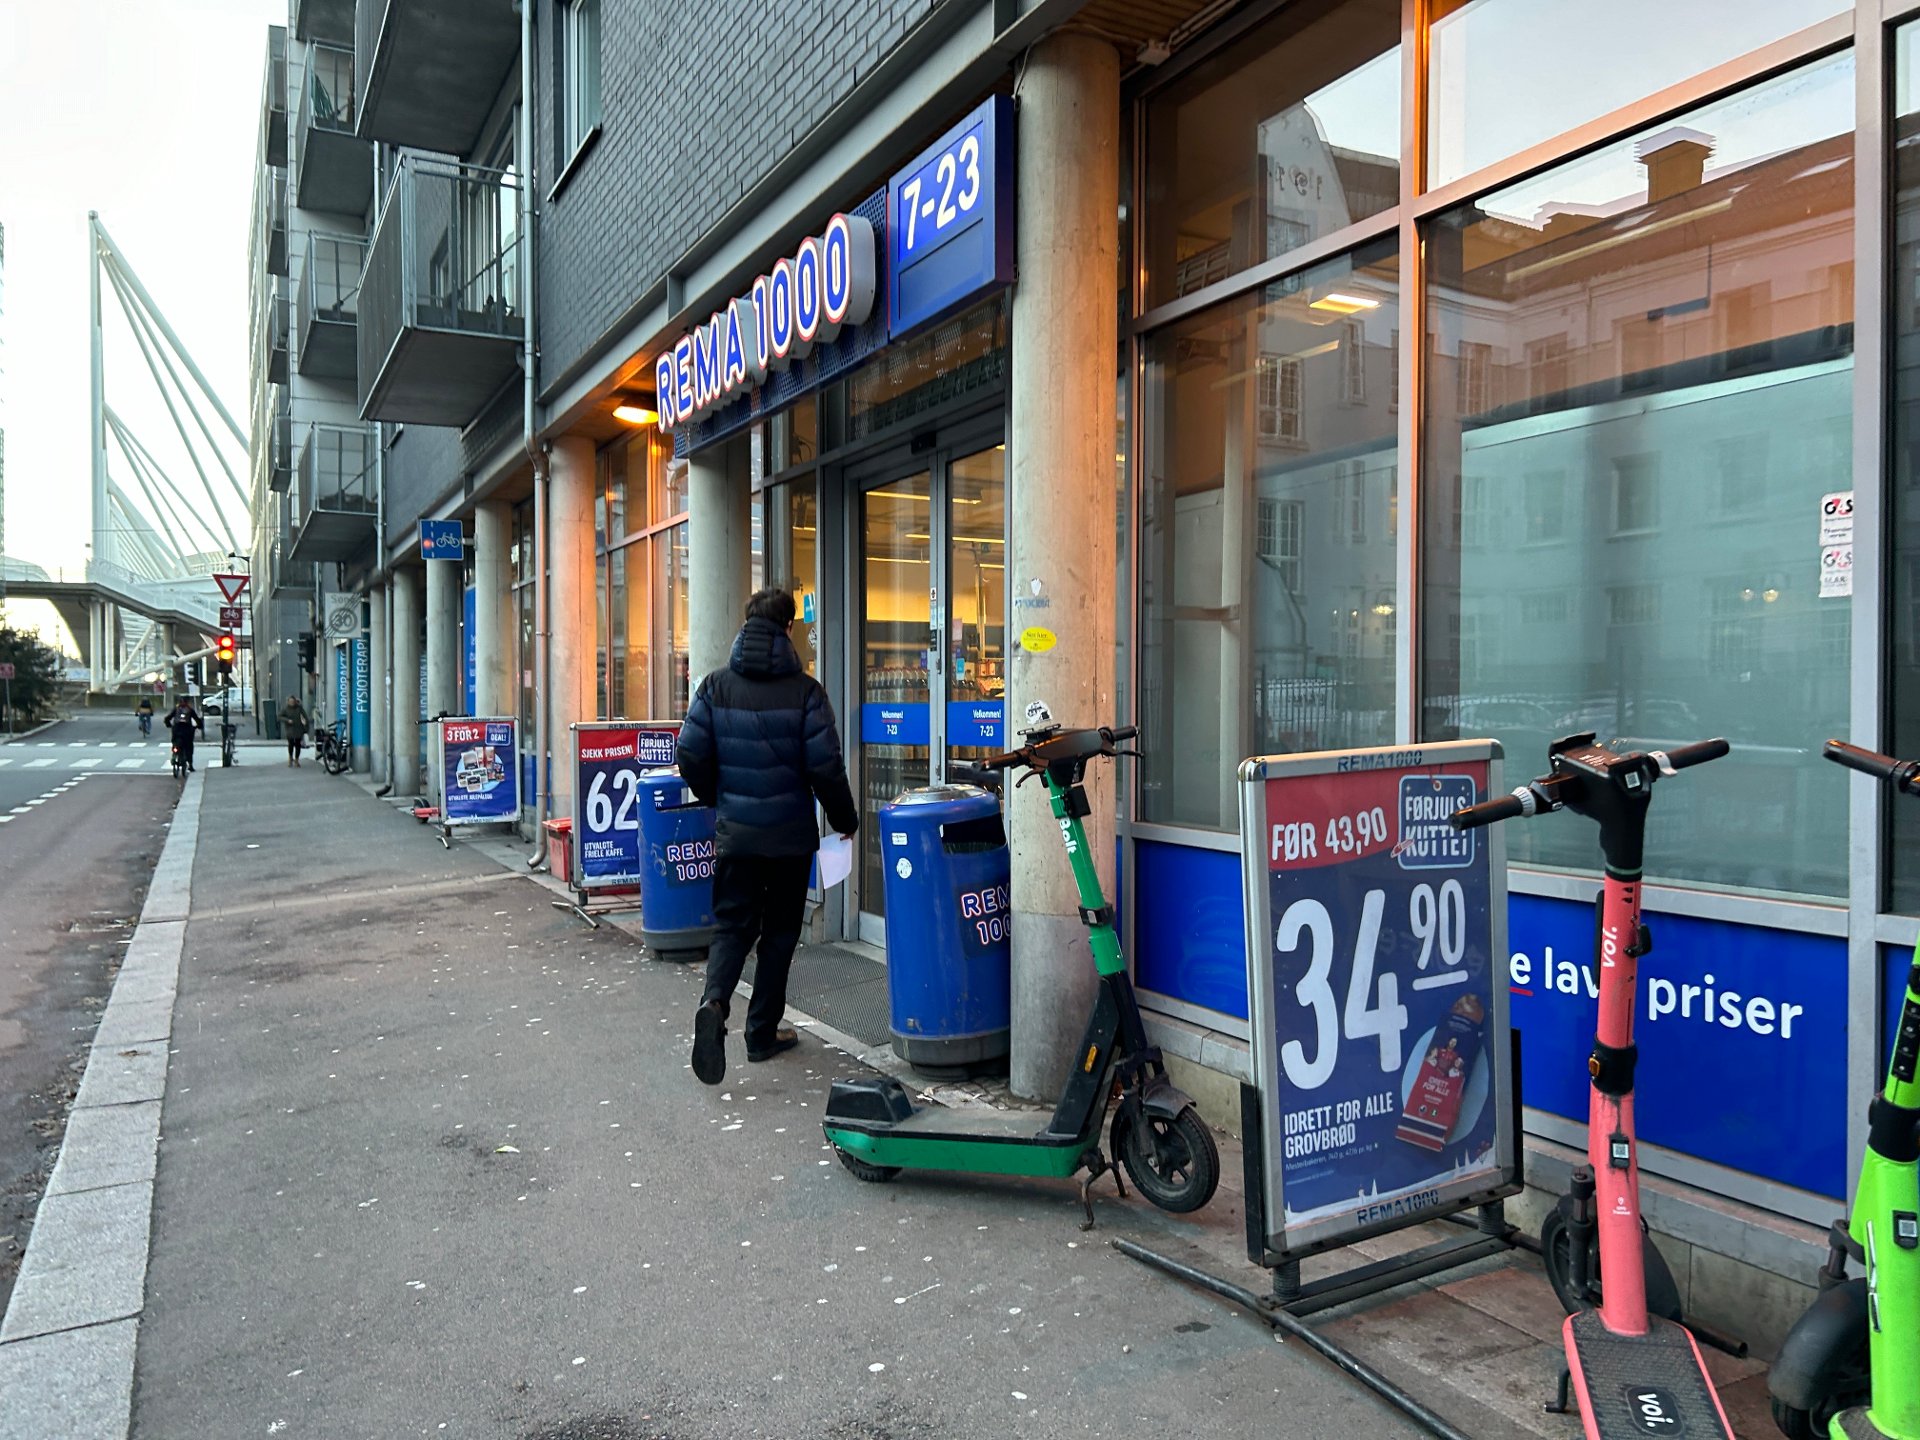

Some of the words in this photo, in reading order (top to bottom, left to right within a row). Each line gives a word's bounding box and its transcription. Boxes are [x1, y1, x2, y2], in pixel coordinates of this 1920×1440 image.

[903, 135, 980, 250] 7-23
[656, 298, 745, 433] REMA
[752, 212, 851, 371] 1000
[887, 725, 898, 735] 7-23
[973, 709, 1002, 719] Velkommen!
[447, 730, 454, 741] 3
[454, 730, 472, 741] FOR
[472, 728, 480, 739] 2
[490, 734, 507, 742] DEAL!
[980, 726, 994, 737] 7-23
[581, 748, 603, 759] SJEKK
[604, 744, 633, 757] PRISEN!
[640, 749, 672, 761] KUTTET
[1337, 750, 1423, 772] REMA1000
[586, 768, 638, 833] 62
[1405, 795, 1470, 822] FØRJULS
[584, 841, 614, 850] UTVALGTE
[667, 840, 716, 862] REM
[1060, 816, 1077, 854] Bolt
[1272, 821, 1317, 862] FØR
[1325, 807, 1387, 855] 43,90
[584, 850, 604, 859] FRIELE
[605, 848, 624, 857] KAFFE
[961, 883, 1011, 918] REM
[976, 913, 1011, 945] 100
[1602, 926, 1619, 968] voi.
[1275, 888, 1409, 1090] 34
[1409, 878, 1466, 970] 90
[1545, 946, 1600, 999] lav
[1649, 974, 1803, 1040] priser
[1284, 1105, 1332, 1136] IDRETT
[1336, 1099, 1361, 1125] FOR
[1364, 1091, 1394, 1118] ALLE
[1284, 1123, 1356, 1159] GROVBRØD
[1357, 1189, 1440, 1225] REMA1000
[1637, 1393, 1674, 1428] voi.
